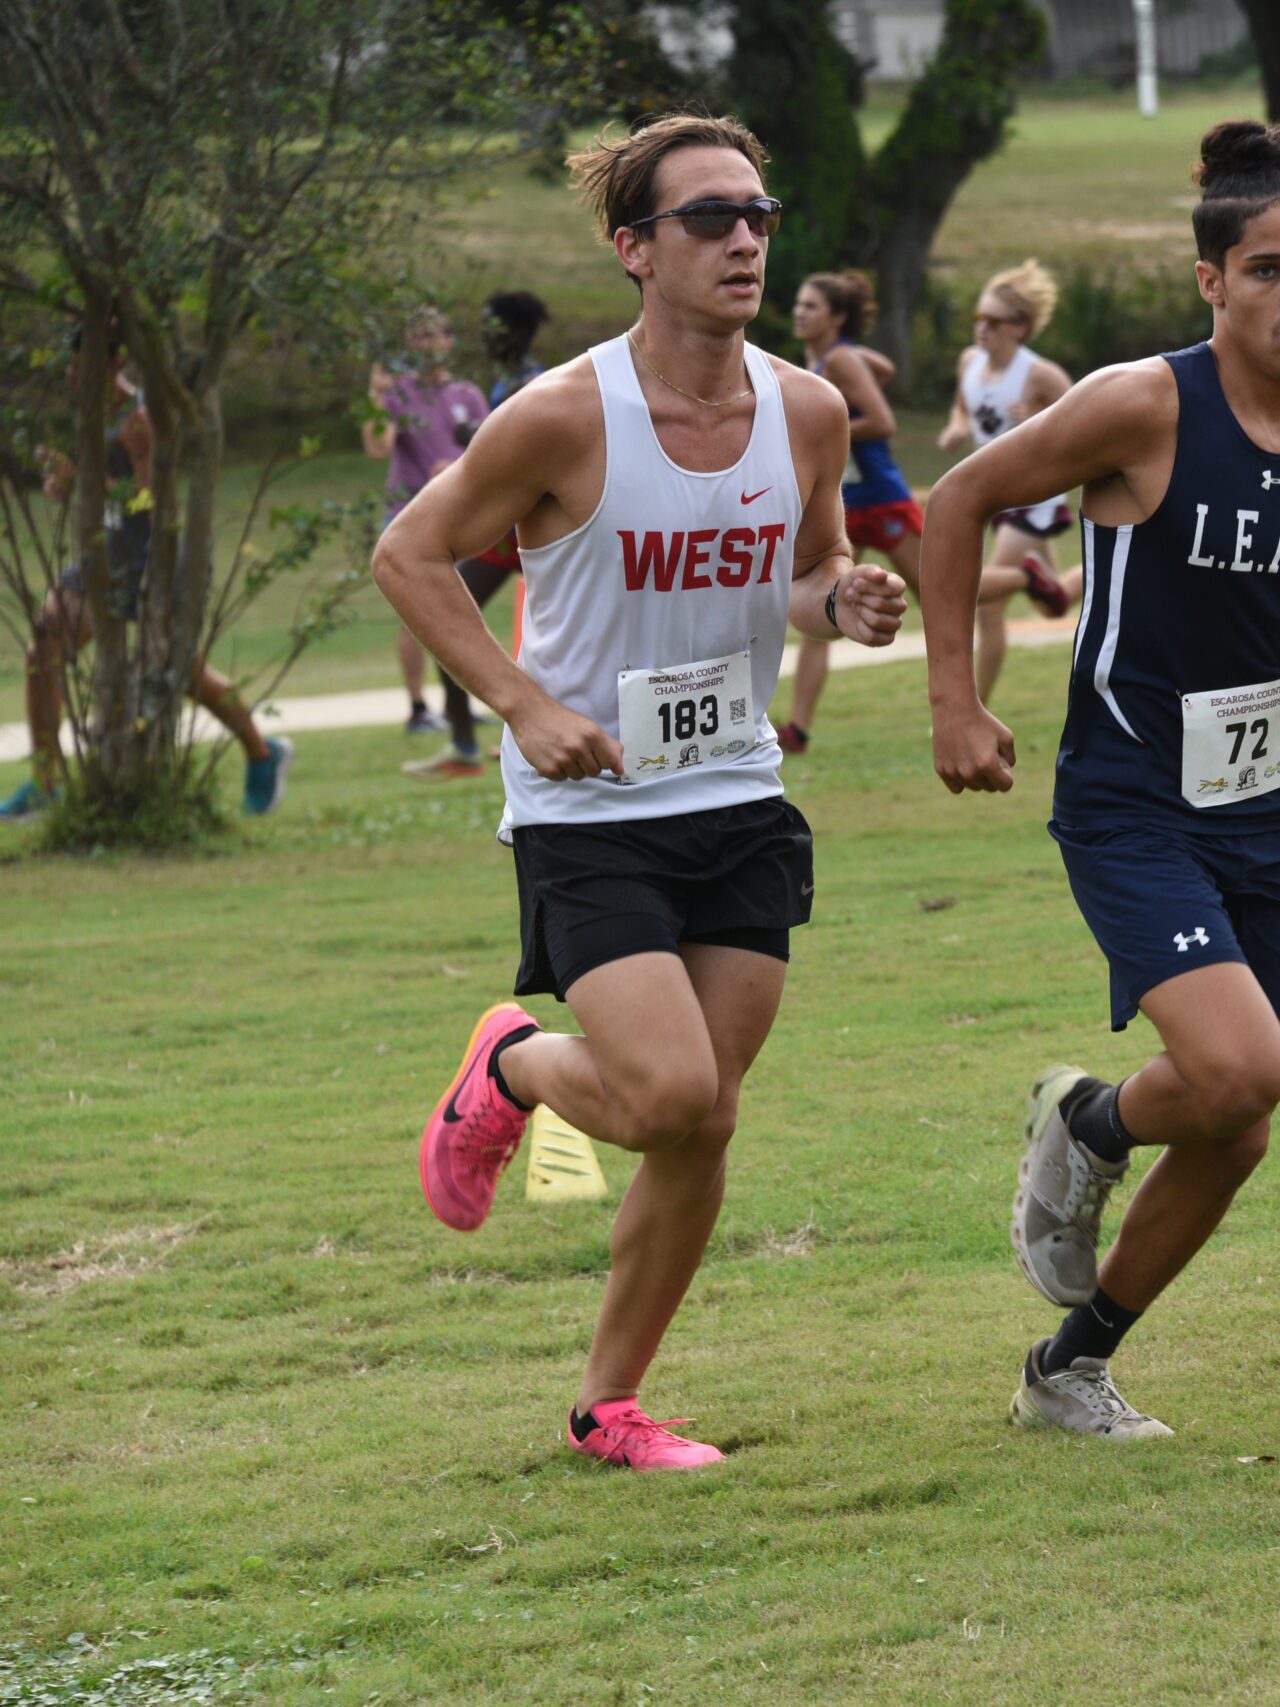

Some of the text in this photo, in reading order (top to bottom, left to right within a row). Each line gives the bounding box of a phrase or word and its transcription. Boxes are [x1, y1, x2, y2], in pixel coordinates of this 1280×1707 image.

[616, 523, 786, 592] WEST
[648, 662, 730, 685] ESCAROSA COUNTY
[654, 676, 725, 696] CHAMPIONSHIPS
[1210, 693, 1255, 707] ESCAROSA
[658, 694, 719, 743] 183
[1225, 717, 1269, 765] 72
